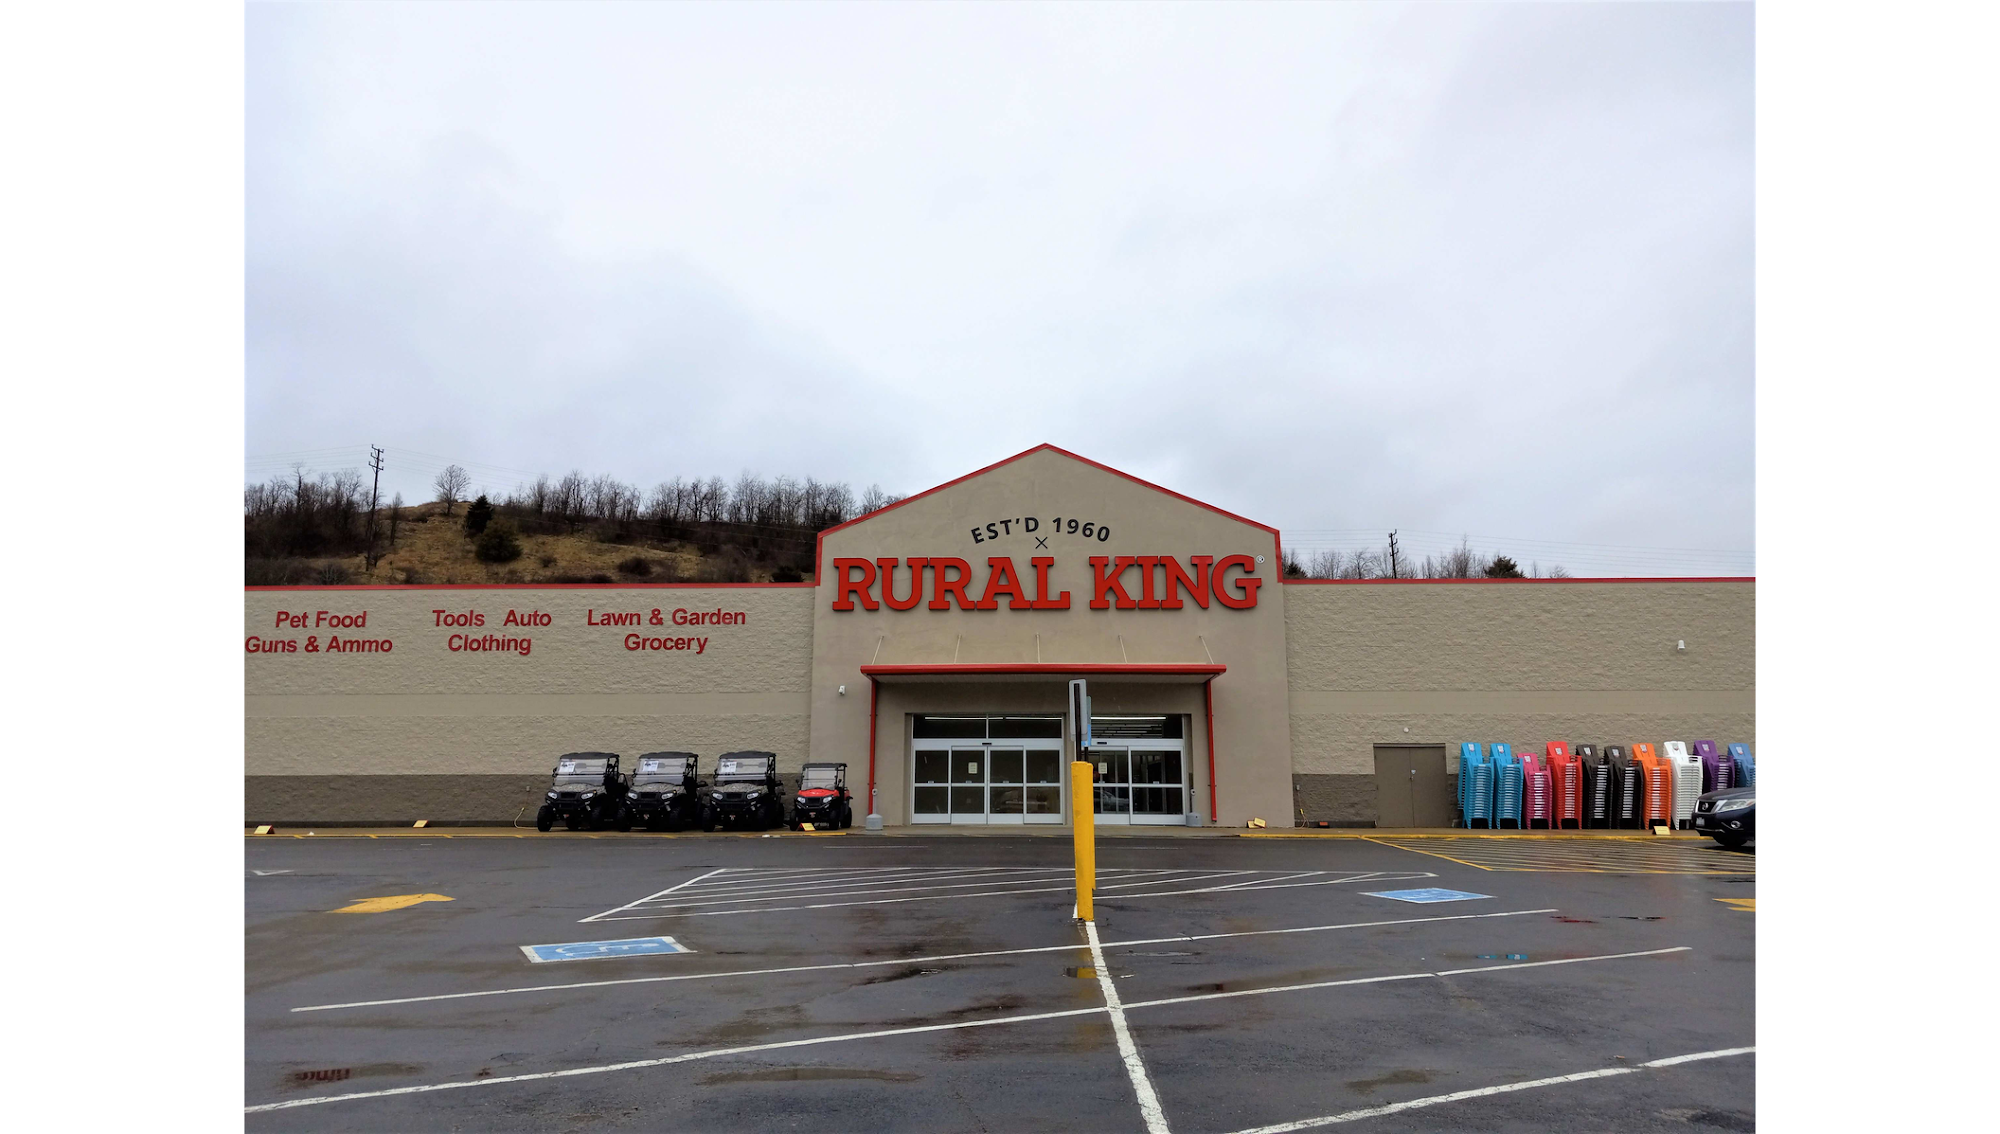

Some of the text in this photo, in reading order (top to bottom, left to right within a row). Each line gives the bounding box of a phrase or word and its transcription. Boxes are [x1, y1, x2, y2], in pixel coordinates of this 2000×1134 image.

[1052, 517, 1111, 543] 1960
[832, 554, 1262, 611] RURAL KING
[275, 610, 367, 628] Pet Food
[432, 608, 552, 627] Tools Auto
[587, 607, 746, 626] Lawn & Garden
[245, 635, 393, 653] Guns & Ammo
[448, 633, 532, 656] Clothing
[624, 632, 709, 655] Grocery
